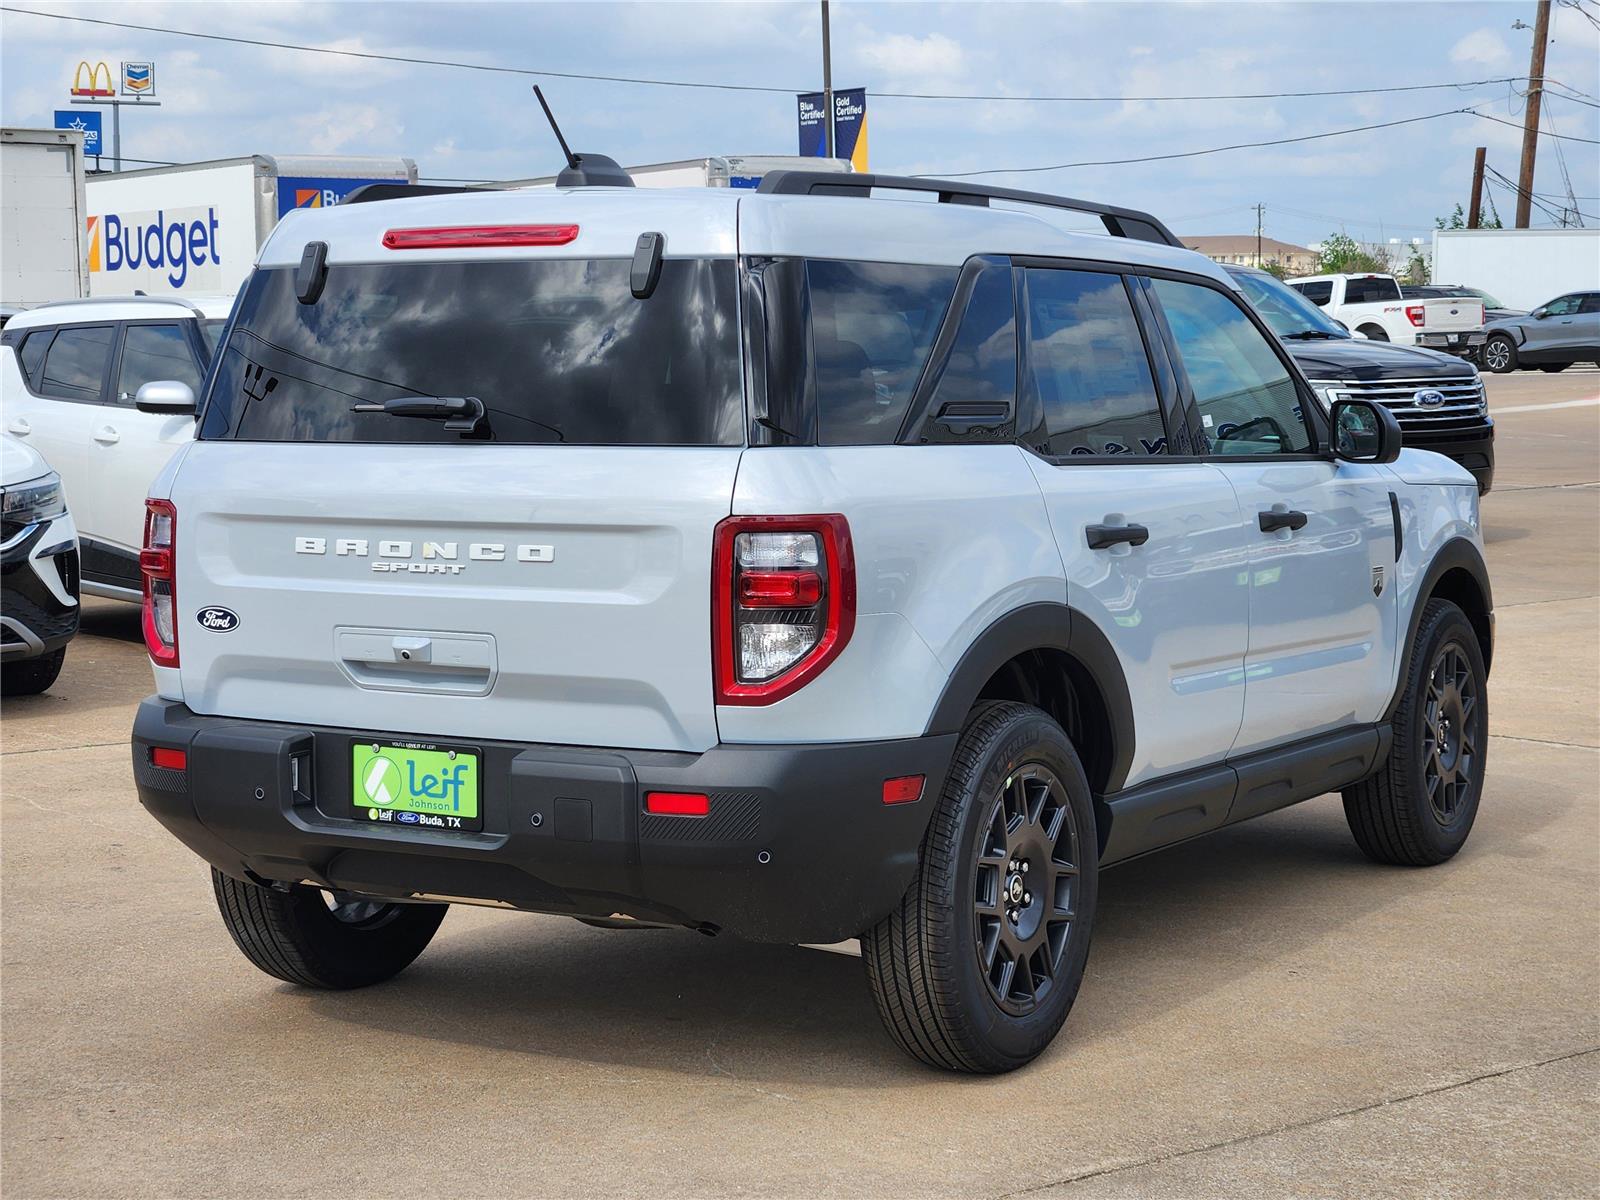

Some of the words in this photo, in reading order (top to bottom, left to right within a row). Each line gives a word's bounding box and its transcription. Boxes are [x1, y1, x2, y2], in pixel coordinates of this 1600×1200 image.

[800, 102, 814, 111] Blue
[835, 97, 850, 107] Gold
[800, 110, 825, 120] Certified
[836, 105, 862, 116] Certified
[104, 207, 220, 289] Budget
[295, 536, 555, 562] BRONCO
[371, 561, 466, 574] SPORT
[203, 610, 231, 628] Ford
[408, 799, 450, 811] Johnson
[420, 814, 445, 827] Buda,
[446, 816, 461, 828] TX
